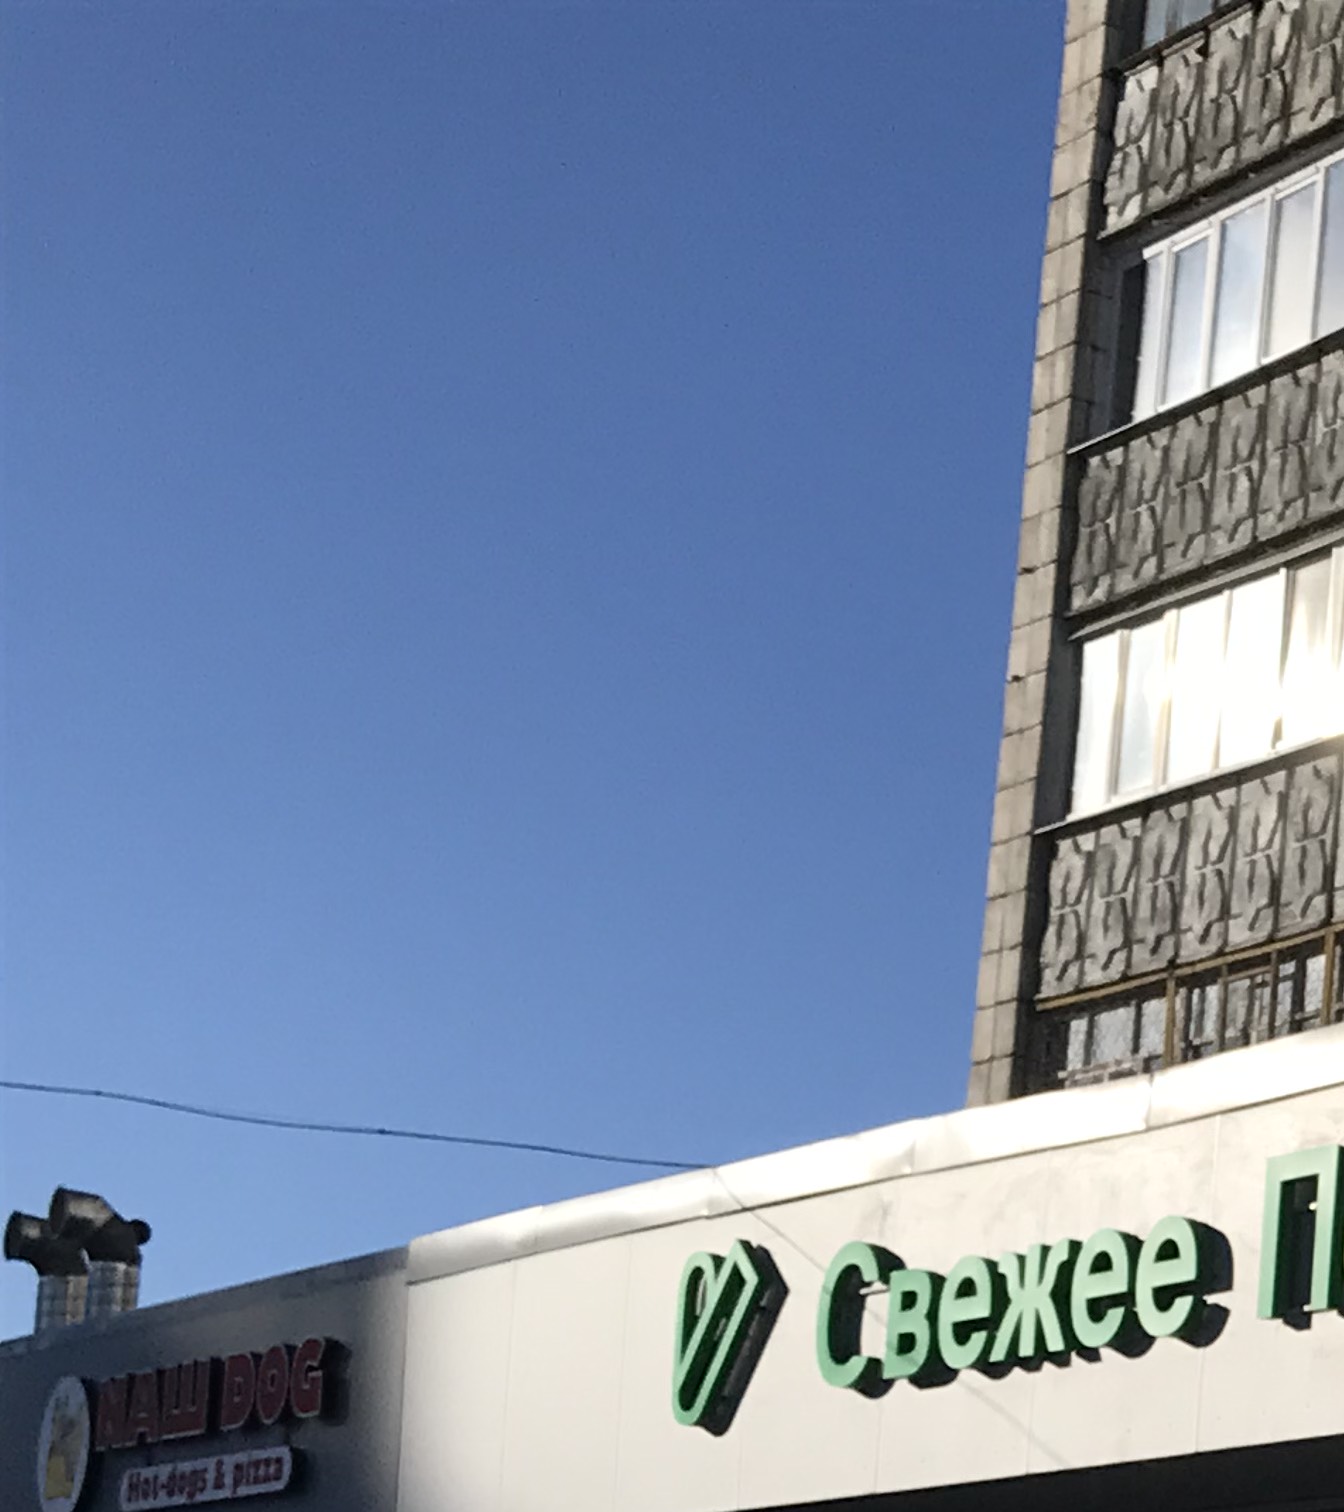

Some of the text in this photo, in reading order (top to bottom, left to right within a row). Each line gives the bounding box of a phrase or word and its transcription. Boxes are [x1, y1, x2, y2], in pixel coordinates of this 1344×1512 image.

[815, 1214, 1204, 1391] Свежее
[220, 1336, 326, 1431] DOG
[230, 1456, 284, 1498] pizza
